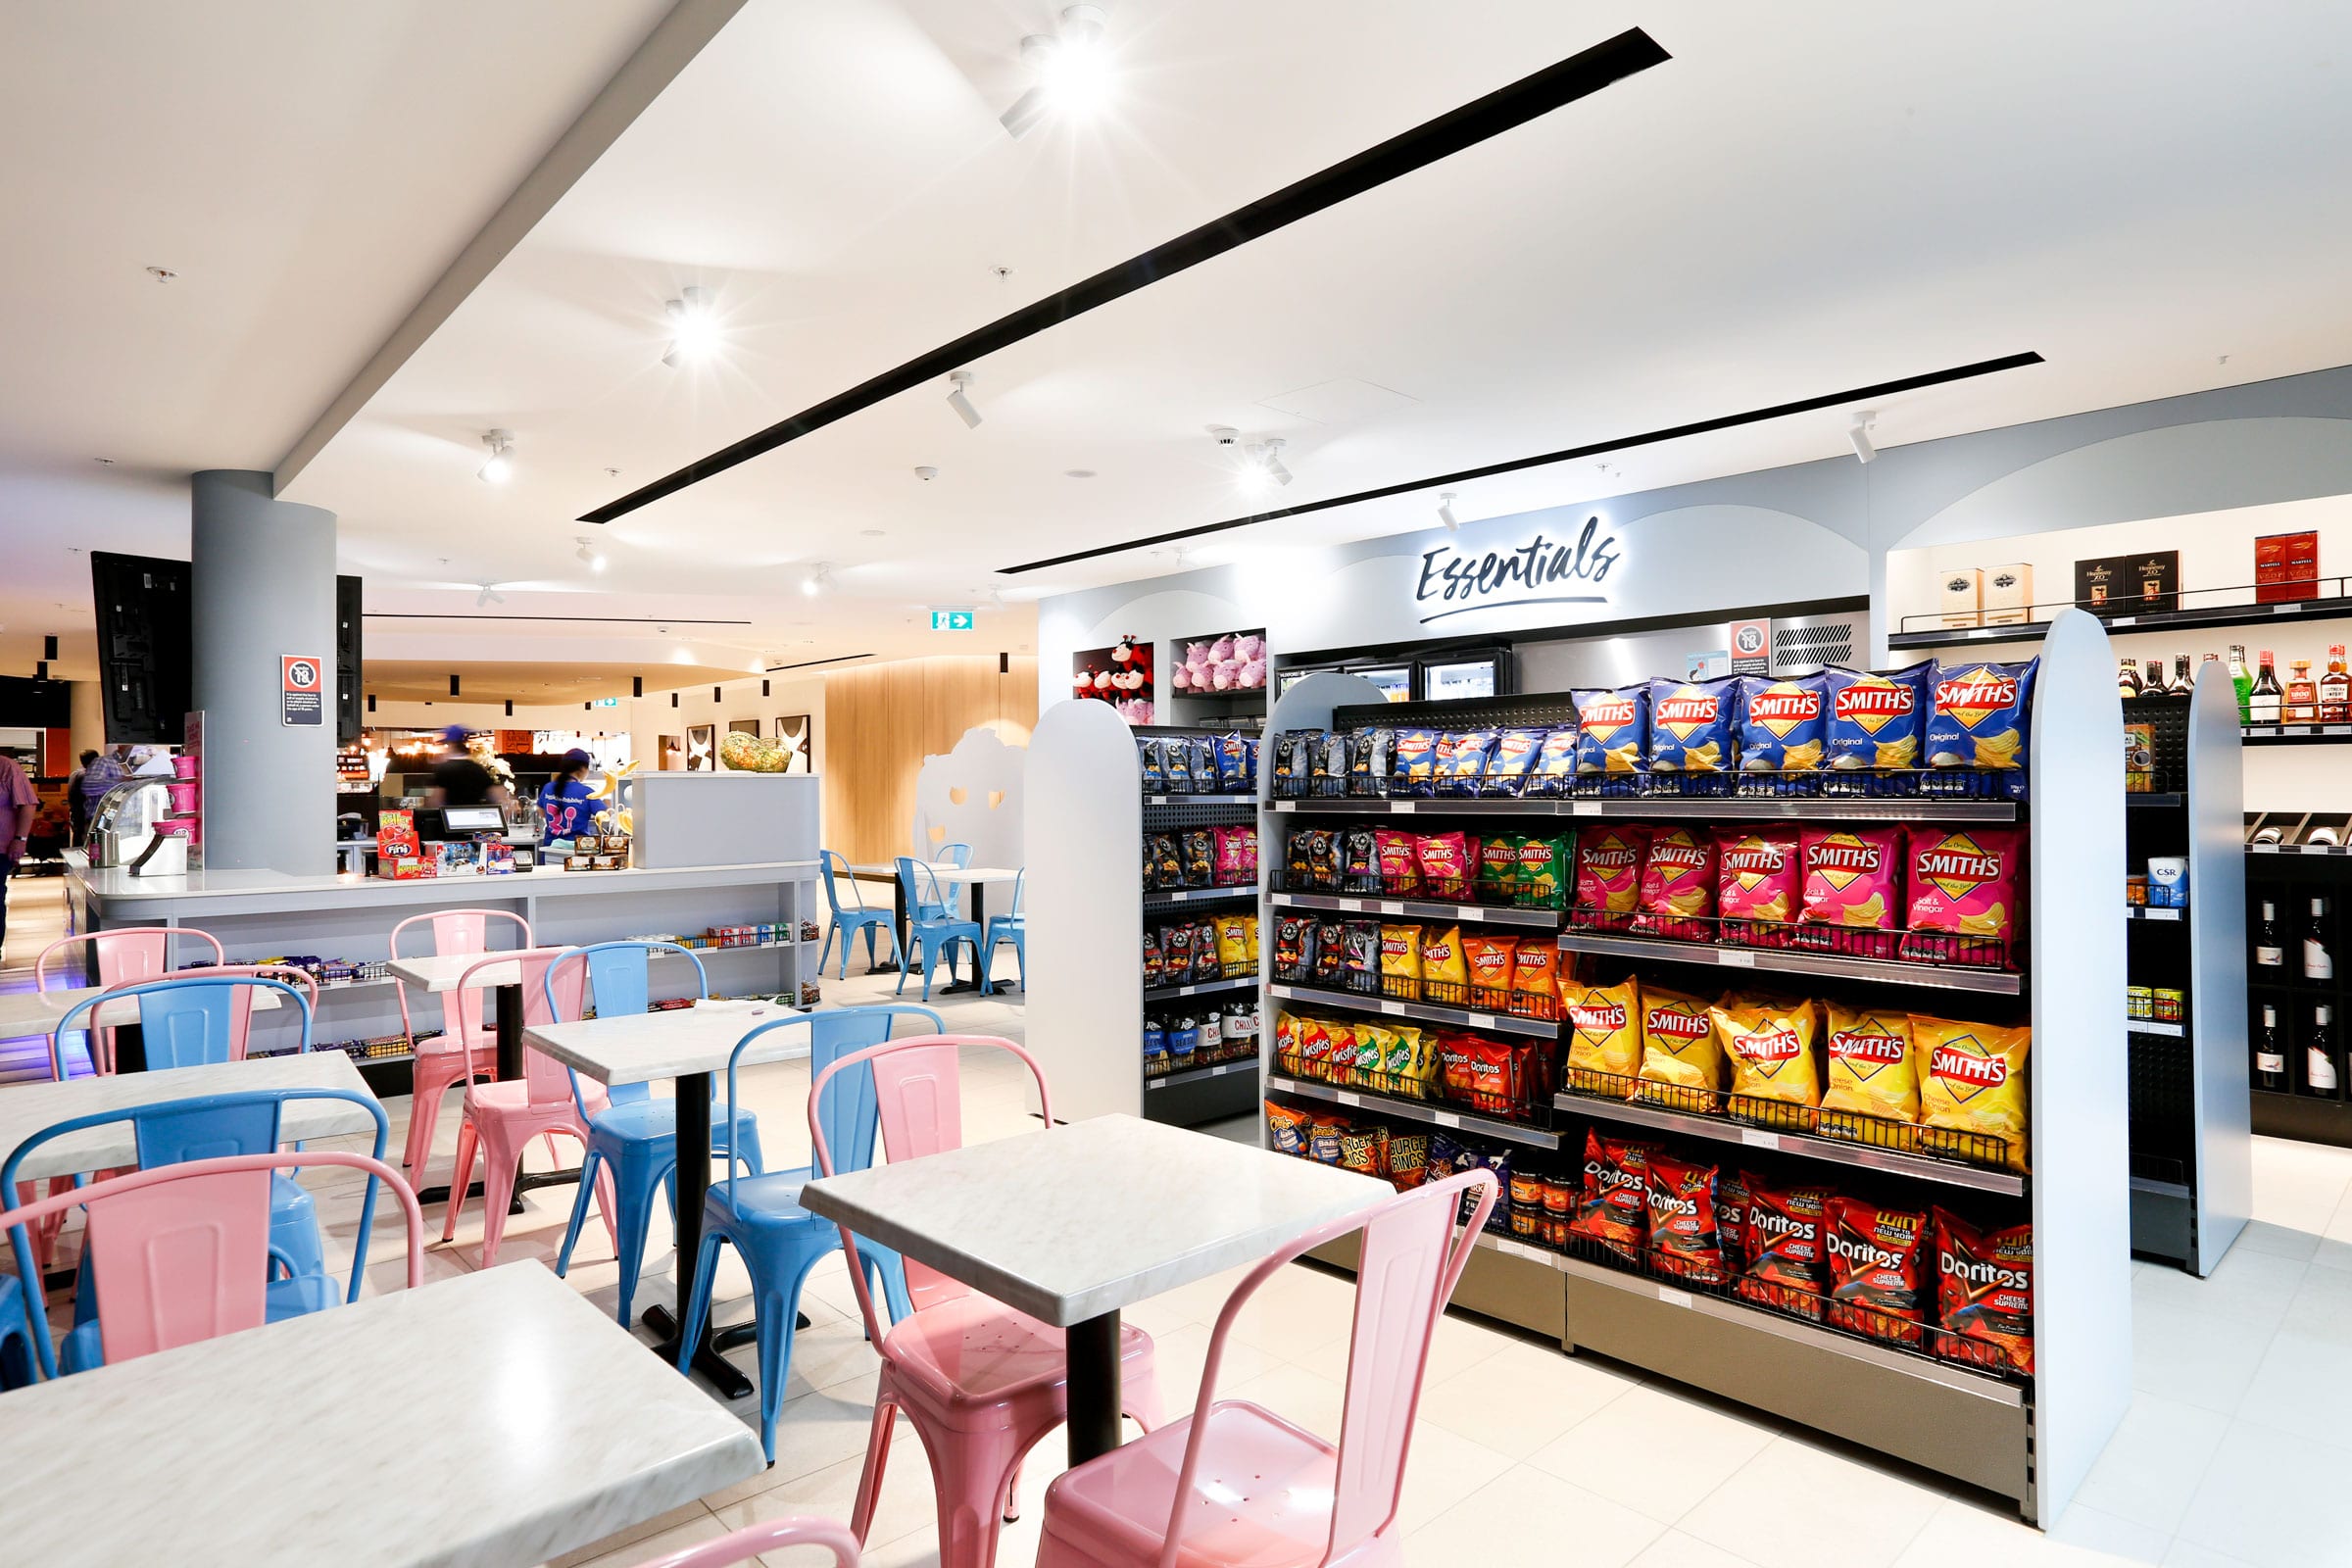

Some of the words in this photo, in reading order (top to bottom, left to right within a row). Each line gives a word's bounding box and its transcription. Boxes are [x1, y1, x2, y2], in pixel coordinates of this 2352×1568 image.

[1417, 516, 1620, 601] Essentials
[1837, 690, 1912, 710] SMITH'S
[1936, 683, 2015, 706] SMITH'S
[1580, 704, 1633, 723] SMITH'S
[1657, 702, 1717, 720] SMITH'S
[1750, 696, 1818, 716] SMITH'S
[1930, 733, 1959, 742] Original
[1382, 846, 1410, 857] SMITH'S
[1423, 850, 1452, 859] SMITH'S
[1483, 848, 1516, 860] SMITH'S
[1519, 848, 1552, 859] SMITH'S
[1953, 842, 1975, 851] Original
[1583, 849, 1637, 864] SMITH'S
[1650, 847, 1708, 865] SMITH'S
[1723, 852, 1784, 870] SMITH'S
[1808, 846, 1879, 867] SMITH'S
[1918, 853, 1999, 876] SMITH'S
[1913, 904, 1944, 913] Vinegar
[1382, 941, 1407, 953] SMITH'S
[1569, 1007, 1625, 1025] SMITH'S
[1648, 1011, 1708, 1034] SMITH'S
[1278, 1034, 1294, 1049] wisties
[1303, 1039, 1330, 1057] Twisties
[1735, 1033, 1798, 1057] SMITH'S
[1830, 1033, 1903, 1058] SMITH'S
[1333, 1045, 1356, 1062] Twistie
[1442, 1053, 1468, 1063] Doritos
[1471, 1060, 1499, 1074] Doritos
[1932, 1050, 2005, 1082] SMITH'S
[1924, 1093, 1950, 1105] Cheese
[1930, 1102, 1950, 1113] Onion
[1391, 1136, 1428, 1156] BURGE
[1392, 1152, 1428, 1173] RINGS
[1615, 1197, 1641, 1207] SUPREME
[1619, 1193, 1639, 1201] CHEESE
[1750, 1206, 1815, 1240] Doritos
[1785, 1248, 1814, 1258] SUPREME
[1788, 1244, 1811, 1252] CHEESE
[1827, 1232, 1903, 1269] Doritos
[1877, 1273, 1902, 1282] CHEESE
[1941, 1251, 2028, 1290] Doritos
[1873, 1277, 1905, 1287] SUPREME
[1994, 1298, 2028, 1310] SUPREME
[1999, 1294, 2026, 1303] CHEESE
